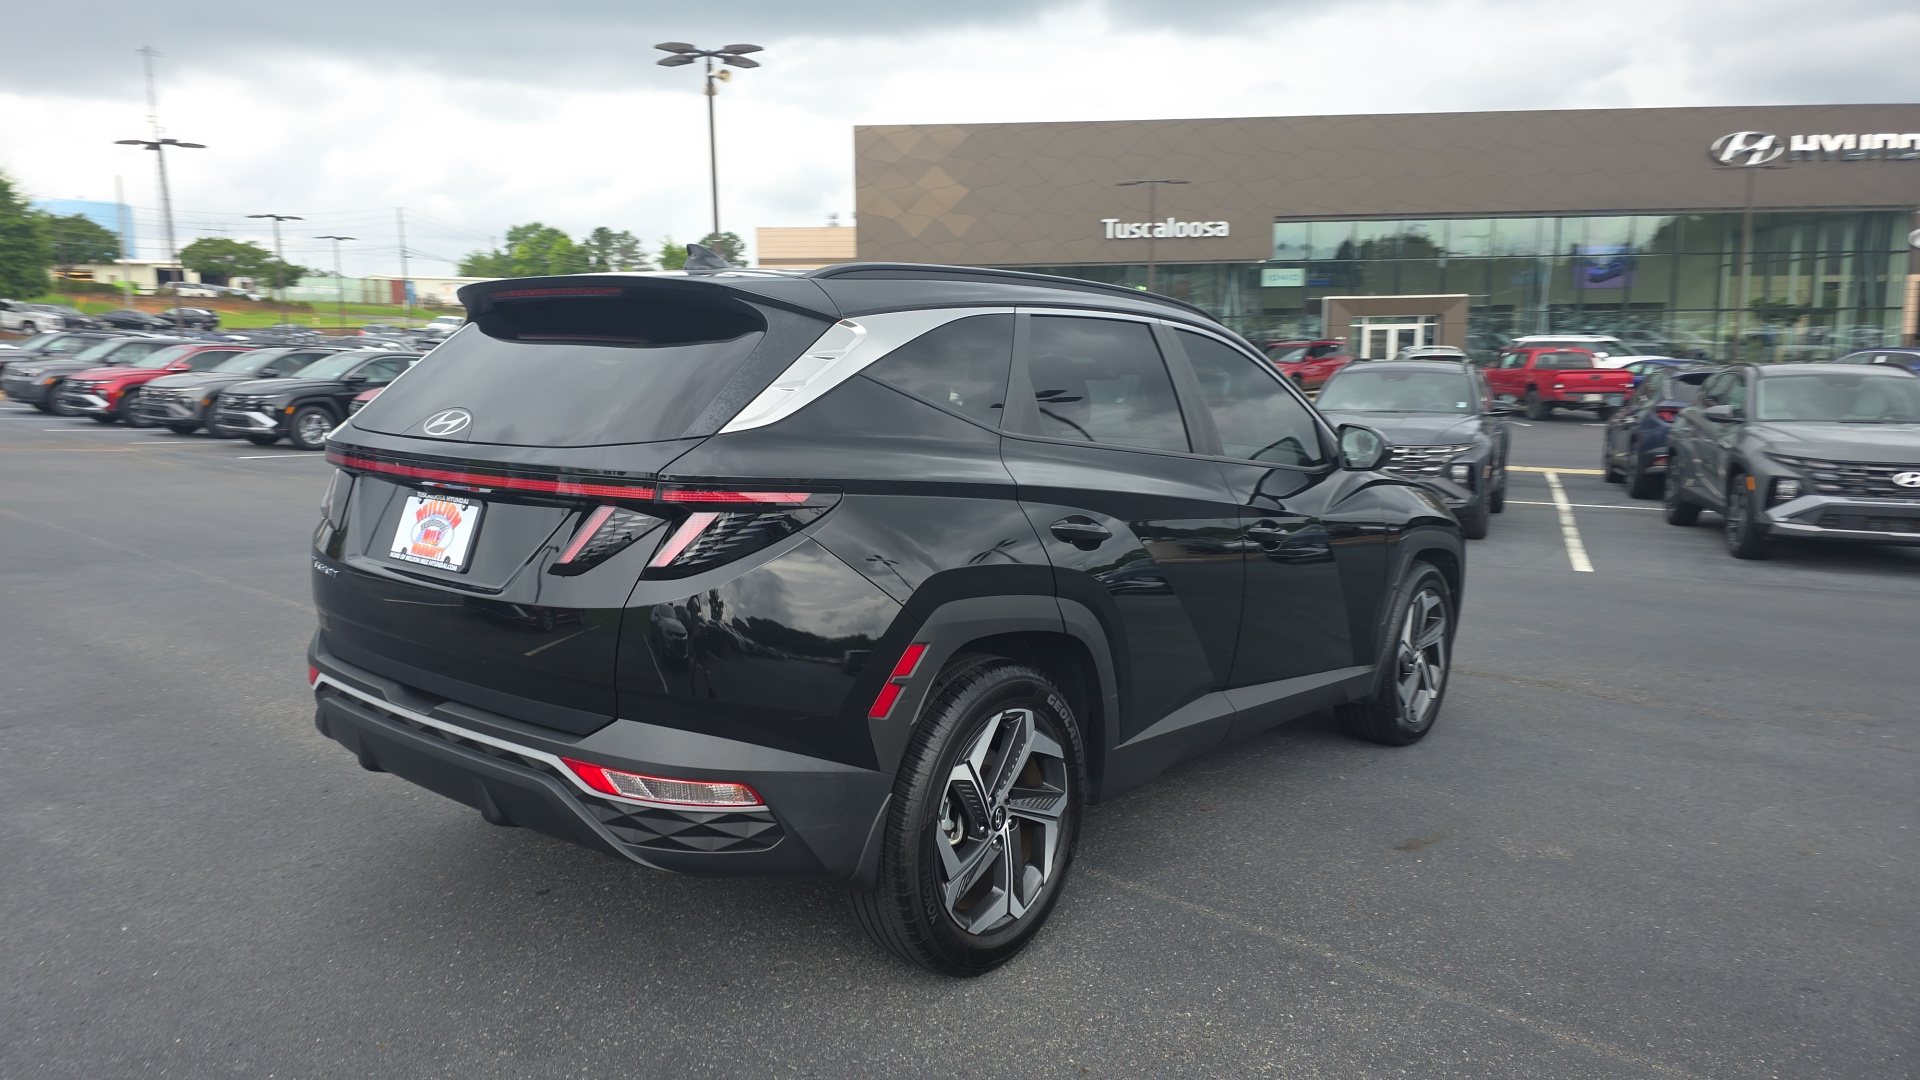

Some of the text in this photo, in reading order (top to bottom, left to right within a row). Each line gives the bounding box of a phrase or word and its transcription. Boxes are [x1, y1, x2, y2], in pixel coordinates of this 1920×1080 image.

[1101, 217, 1230, 239] Tuscaloosa
[446, 495, 469, 505] HYUNDAI
[416, 500, 462, 530] MILLION
[422, 528, 442, 546] MILE
[920, 845, 938, 925] YOKOHA
